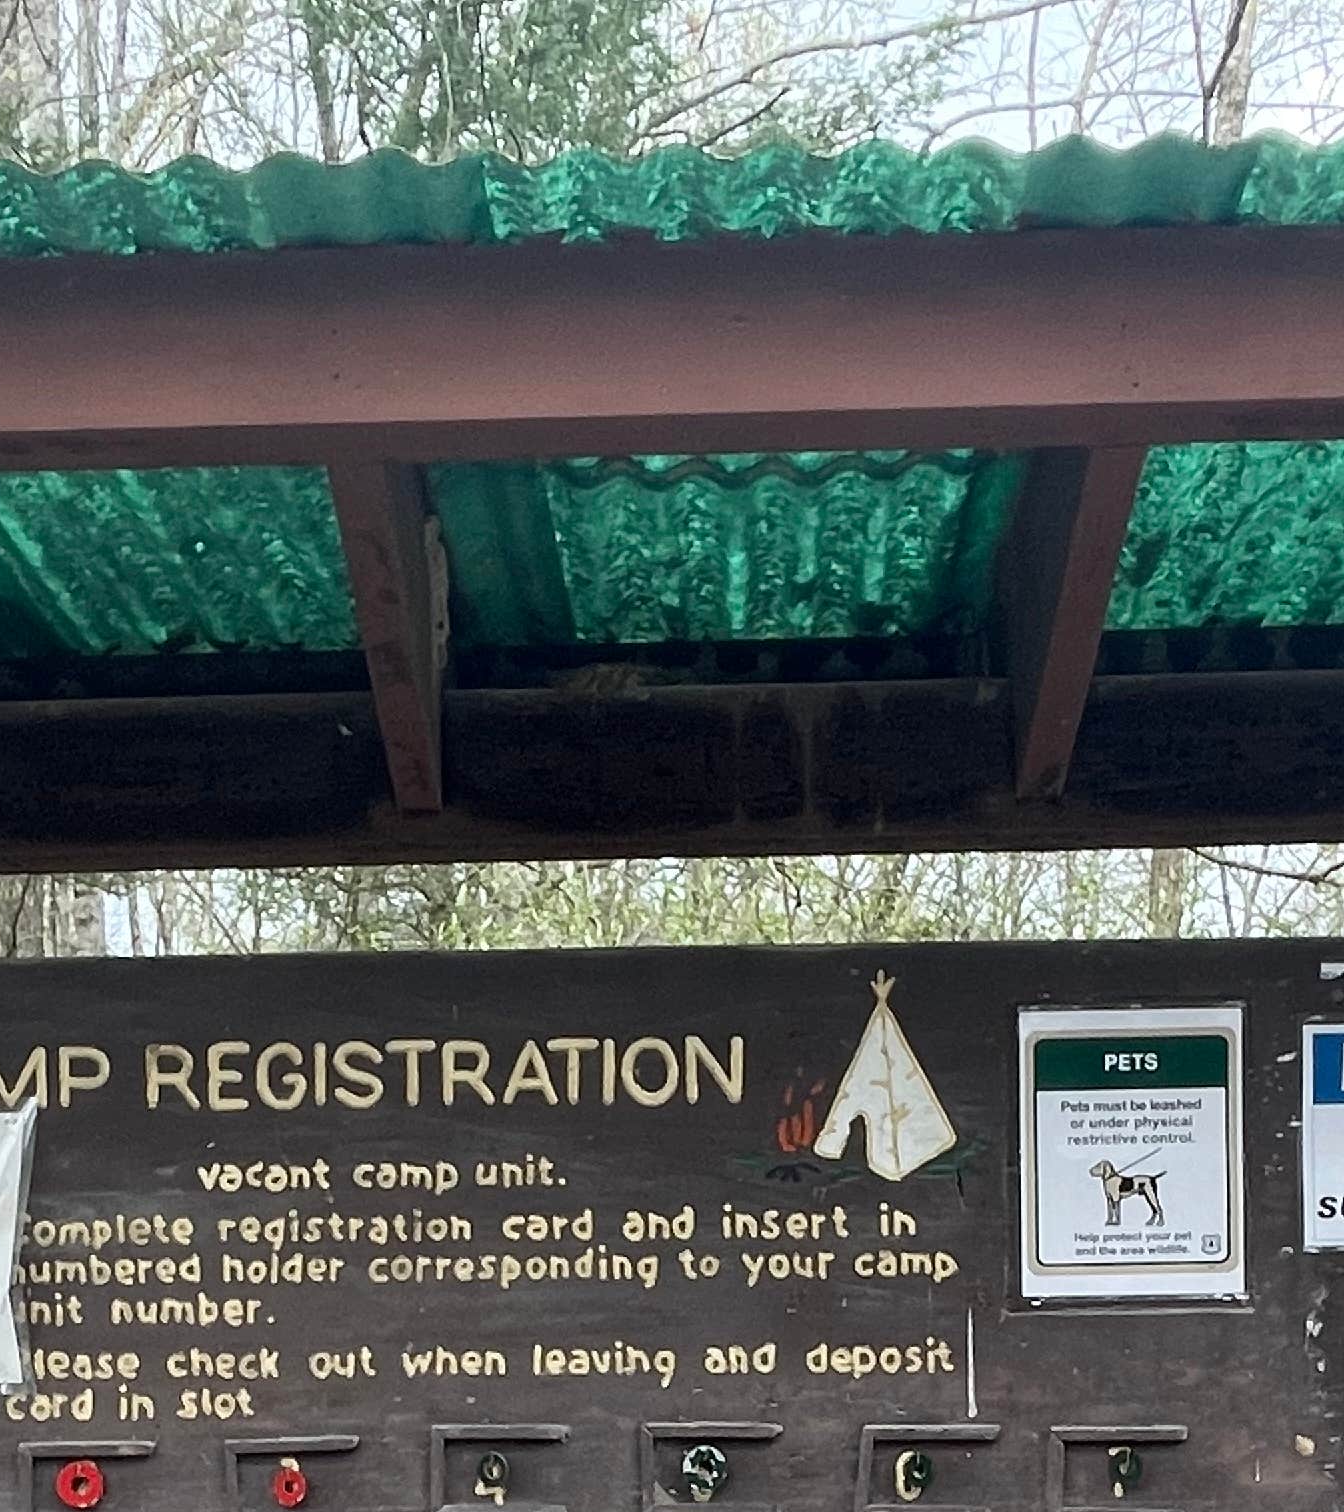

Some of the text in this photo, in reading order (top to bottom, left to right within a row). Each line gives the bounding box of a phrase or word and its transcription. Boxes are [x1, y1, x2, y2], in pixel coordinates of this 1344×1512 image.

[144, 1035, 744, 1111] REGISTRATION
[1104, 1053, 1158, 1072] PETS
[1060, 1098, 1202, 1112] Pets must be leashed
[1070, 1115, 1193, 1131] or under physical
[1067, 1131, 1196, 1145] restrictive control.
[197, 1153, 567, 1194] vacant camp unit.
[218, 1207, 472, 1250] registration
[502, 1208, 593, 1241] card
[622, 1205, 694, 1240] and
[722, 1203, 849, 1240] insert
[880, 1203, 917, 1236] in
[221, 1251, 345, 1285] holder
[368, 1245, 659, 1287] corresponding
[678, 1252, 720, 1279] to
[741, 1248, 835, 1287] your
[855, 1248, 958, 1282] camp
[111, 1293, 276, 1326] number.
[28, 1336, 956, 1388] lease check out when leaving and deposit
[6, 1384, 254, 1421] card in slot
